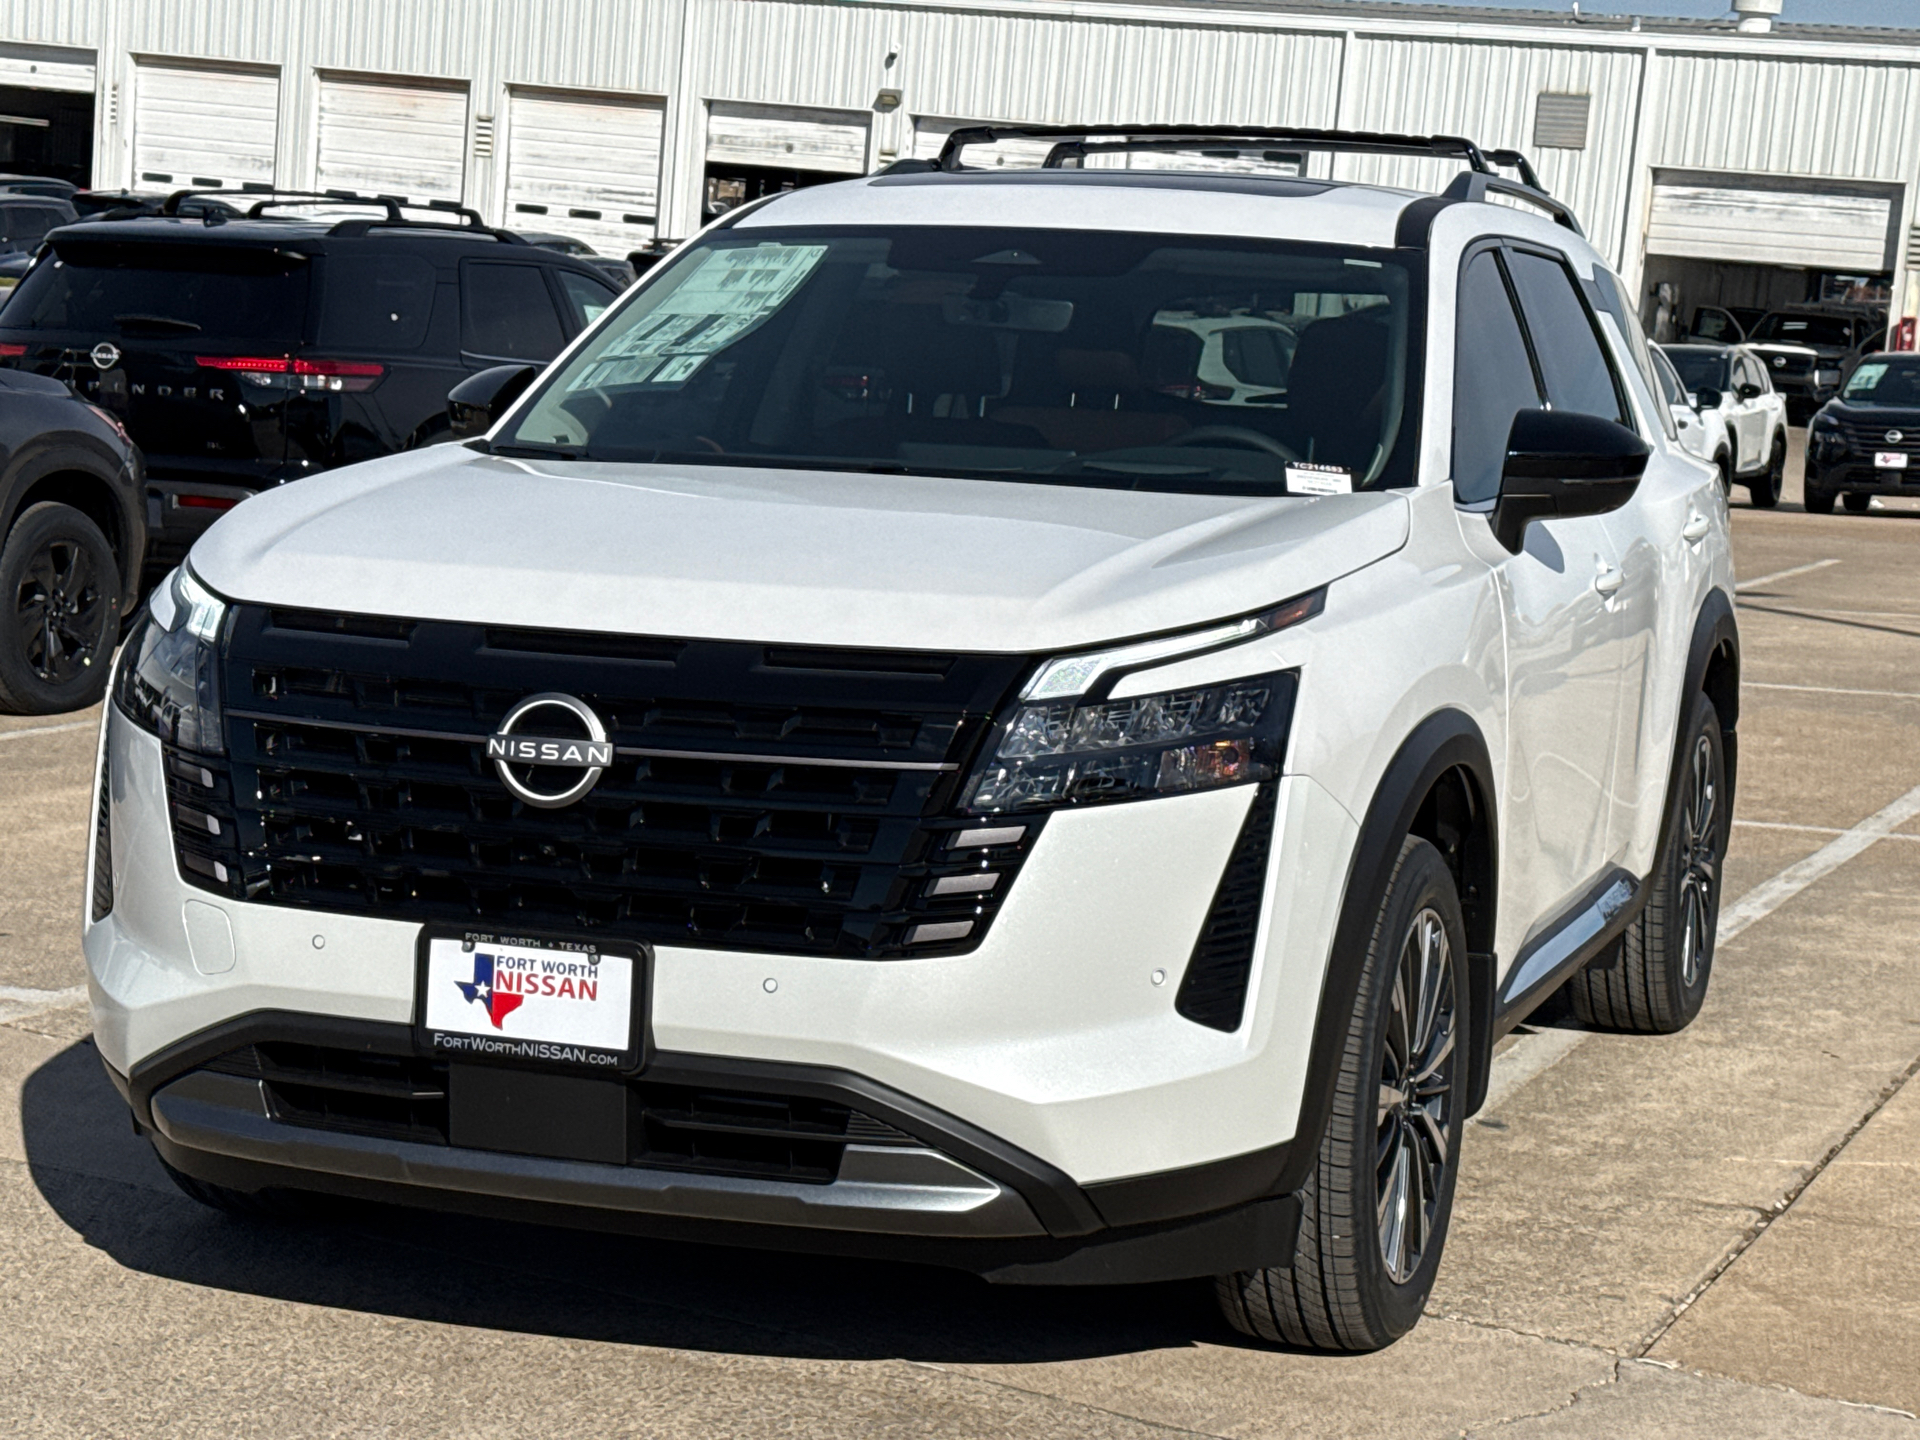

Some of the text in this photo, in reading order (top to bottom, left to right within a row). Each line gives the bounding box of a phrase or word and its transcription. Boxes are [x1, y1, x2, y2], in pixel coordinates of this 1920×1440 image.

[488, 738, 608, 763] NISSAN
[465, 932, 596, 953] FORT WORTH TEXAS
[496, 955, 598, 979] FORT WORTH
[495, 969, 598, 1001] NISSAN
